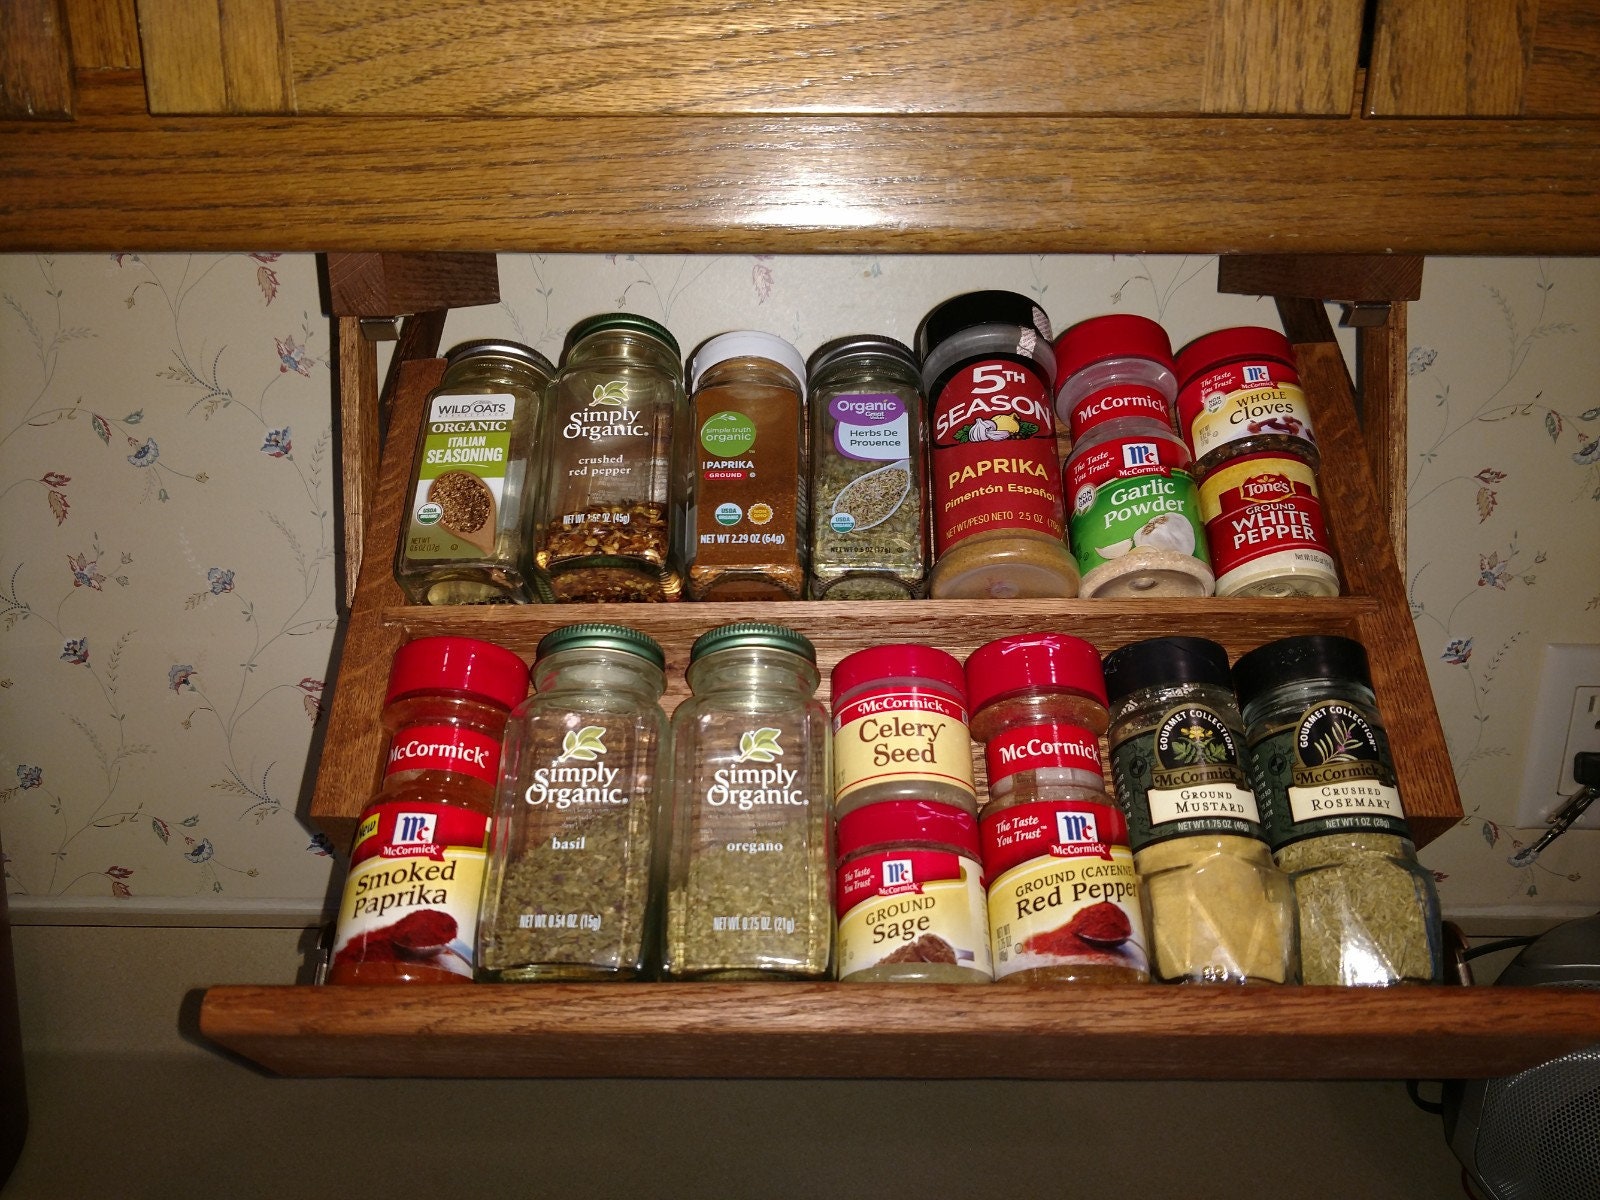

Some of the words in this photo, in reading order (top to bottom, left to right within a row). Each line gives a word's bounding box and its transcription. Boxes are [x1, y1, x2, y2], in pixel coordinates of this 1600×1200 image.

[1201, 379, 1211, 388] The
[1213, 372, 1231, 380] Taste
[837, 399, 896, 414] Organic
[1236, 392, 1286, 407] WHOLE
[439, 405, 470, 414] WILD
[474, 404, 505, 412] OATS
[1079, 396, 1168, 423] McCormick
[1229, 402, 1294, 425] Cloves
[936, 395, 1051, 440] SEASON
[432, 422, 506, 433] ORGANIC
[448, 436, 486, 447] ITALIAN
[706, 432, 751, 442] organic
[427, 448, 503, 464] SEASONING
[579, 455, 623, 465] crushed
[1073, 462, 1086, 474] The
[1086, 451, 1109, 465] Taste
[569, 467, 587, 476] red
[592, 467, 631, 477] pepper
[707, 461, 754, 469] PAPRIKA
[949, 459, 1049, 489] PAPRIKA
[1074, 471, 1087, 484] You
[945, 483, 1003, 512] Pimentón
[1008, 484, 1056, 503] Español
[1078, 489, 1092, 502] NON
[1111, 479, 1175, 506] Garlic
[1079, 496, 1093, 508] GMO
[1245, 503, 1295, 515] GROUND
[992, 511, 1013, 521] NETO
[1019, 512, 1031, 520] 2.5
[1034, 514, 1043, 523] OZ
[1104, 496, 1184, 529] Powder
[1231, 510, 1311, 533] WHITE
[701, 534, 715, 543] NET
[717, 534, 730, 543] WT
[732, 534, 748, 543] 2.29
[750, 534, 761, 543] OZ
[762, 534, 785, 544] (64g)
[1234, 525, 1316, 549] PEPPER
[859, 717, 945, 742] Celery
[1160, 711, 1187, 750] GOURMET
[1190, 710, 1234, 750] COLLECTION
[1300, 708, 1327, 748] GOURMET
[1329, 707, 1376, 746] COLLECTION
[873, 743, 937, 767] Seed
[999, 739, 1100, 766] McCormick
[1181, 791, 1232, 800] GROUND
[1322, 787, 1381, 796] CRUSHED
[1176, 801, 1244, 813] MUSTARD
[1311, 799, 1390, 811] ROSEMARY
[996, 821, 1011, 834] The
[1012, 816, 1039, 828] Taste
[1178, 822, 1192, 830] NET
[1326, 819, 1340, 828] NET
[1341, 818, 1354, 826] WT
[552, 837, 586, 850] basil
[726, 841, 783, 854] oregano
[997, 834, 1014, 847] You
[356, 860, 456, 896] Smoked
[844, 872, 854, 883] The
[855, 867, 871, 878] Taste
[1015, 871, 1075, 897] GROUND
[352, 885, 447, 919] Paprika
[1016, 885, 1062, 920] Red
[1072, 882, 1137, 902] Pepper
[865, 897, 936, 926] GROUND
[520, 914, 534, 928] NET
[548, 915, 566, 928] 0.54
[580, 915, 601, 930] (15g)
[713, 917, 726, 930] NET
[774, 917, 795, 934] (21g)
[872, 915, 930, 944] Sage
